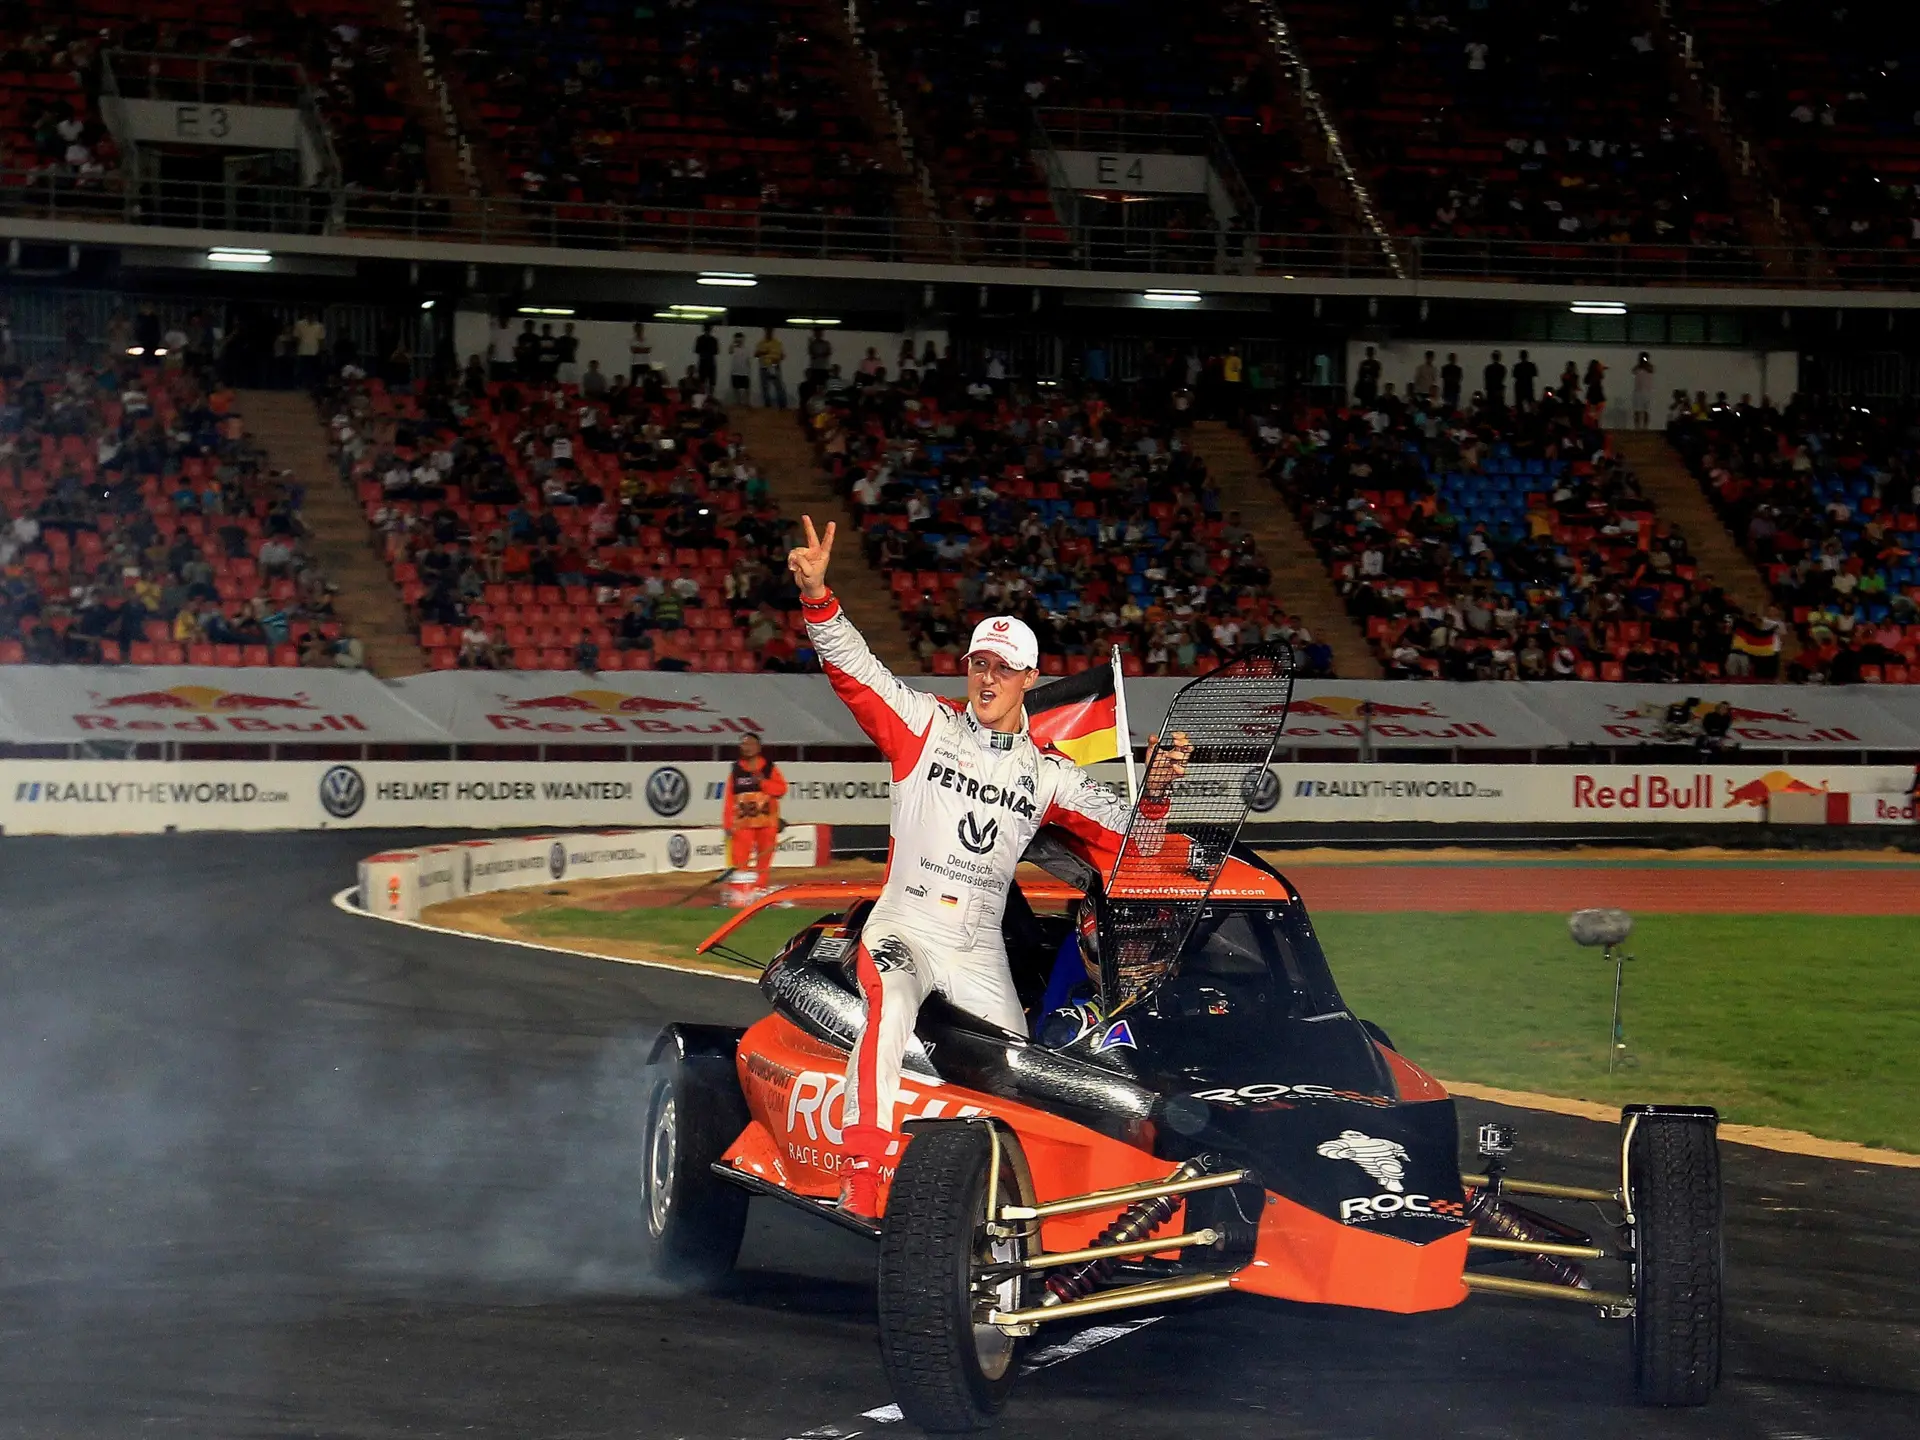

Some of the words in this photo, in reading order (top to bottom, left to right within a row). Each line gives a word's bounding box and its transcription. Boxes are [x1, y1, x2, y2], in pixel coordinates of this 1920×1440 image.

[1098, 156, 1144, 184] E4
[72, 714, 220, 731] Red
[226, 714, 368, 731] Bull
[485, 714, 626, 732] Red
[630, 717, 764, 733] Bull
[1240, 723, 1364, 737] Red
[1369, 722, 1497, 737] Bull
[1733, 727, 1861, 742] Bull
[377, 781, 450, 801] HELMET
[457, 781, 536, 800] HOLDER
[541, 781, 633, 800] WANTED!
[927, 762, 1036, 820] PETRONAS
[1573, 774, 1641, 809] Red
[1648, 774, 1713, 809] Bull
[1121, 887, 1266, 897] raceofchampons.com
[1189, 1083, 1336, 1102] ROC
[1340, 1193, 1433, 1219] ROC
[1343, 1215, 1377, 1226] RACE
[1380, 1211, 1397, 1219] OF
[1402, 1211, 1473, 1227] CHAMPIONS
